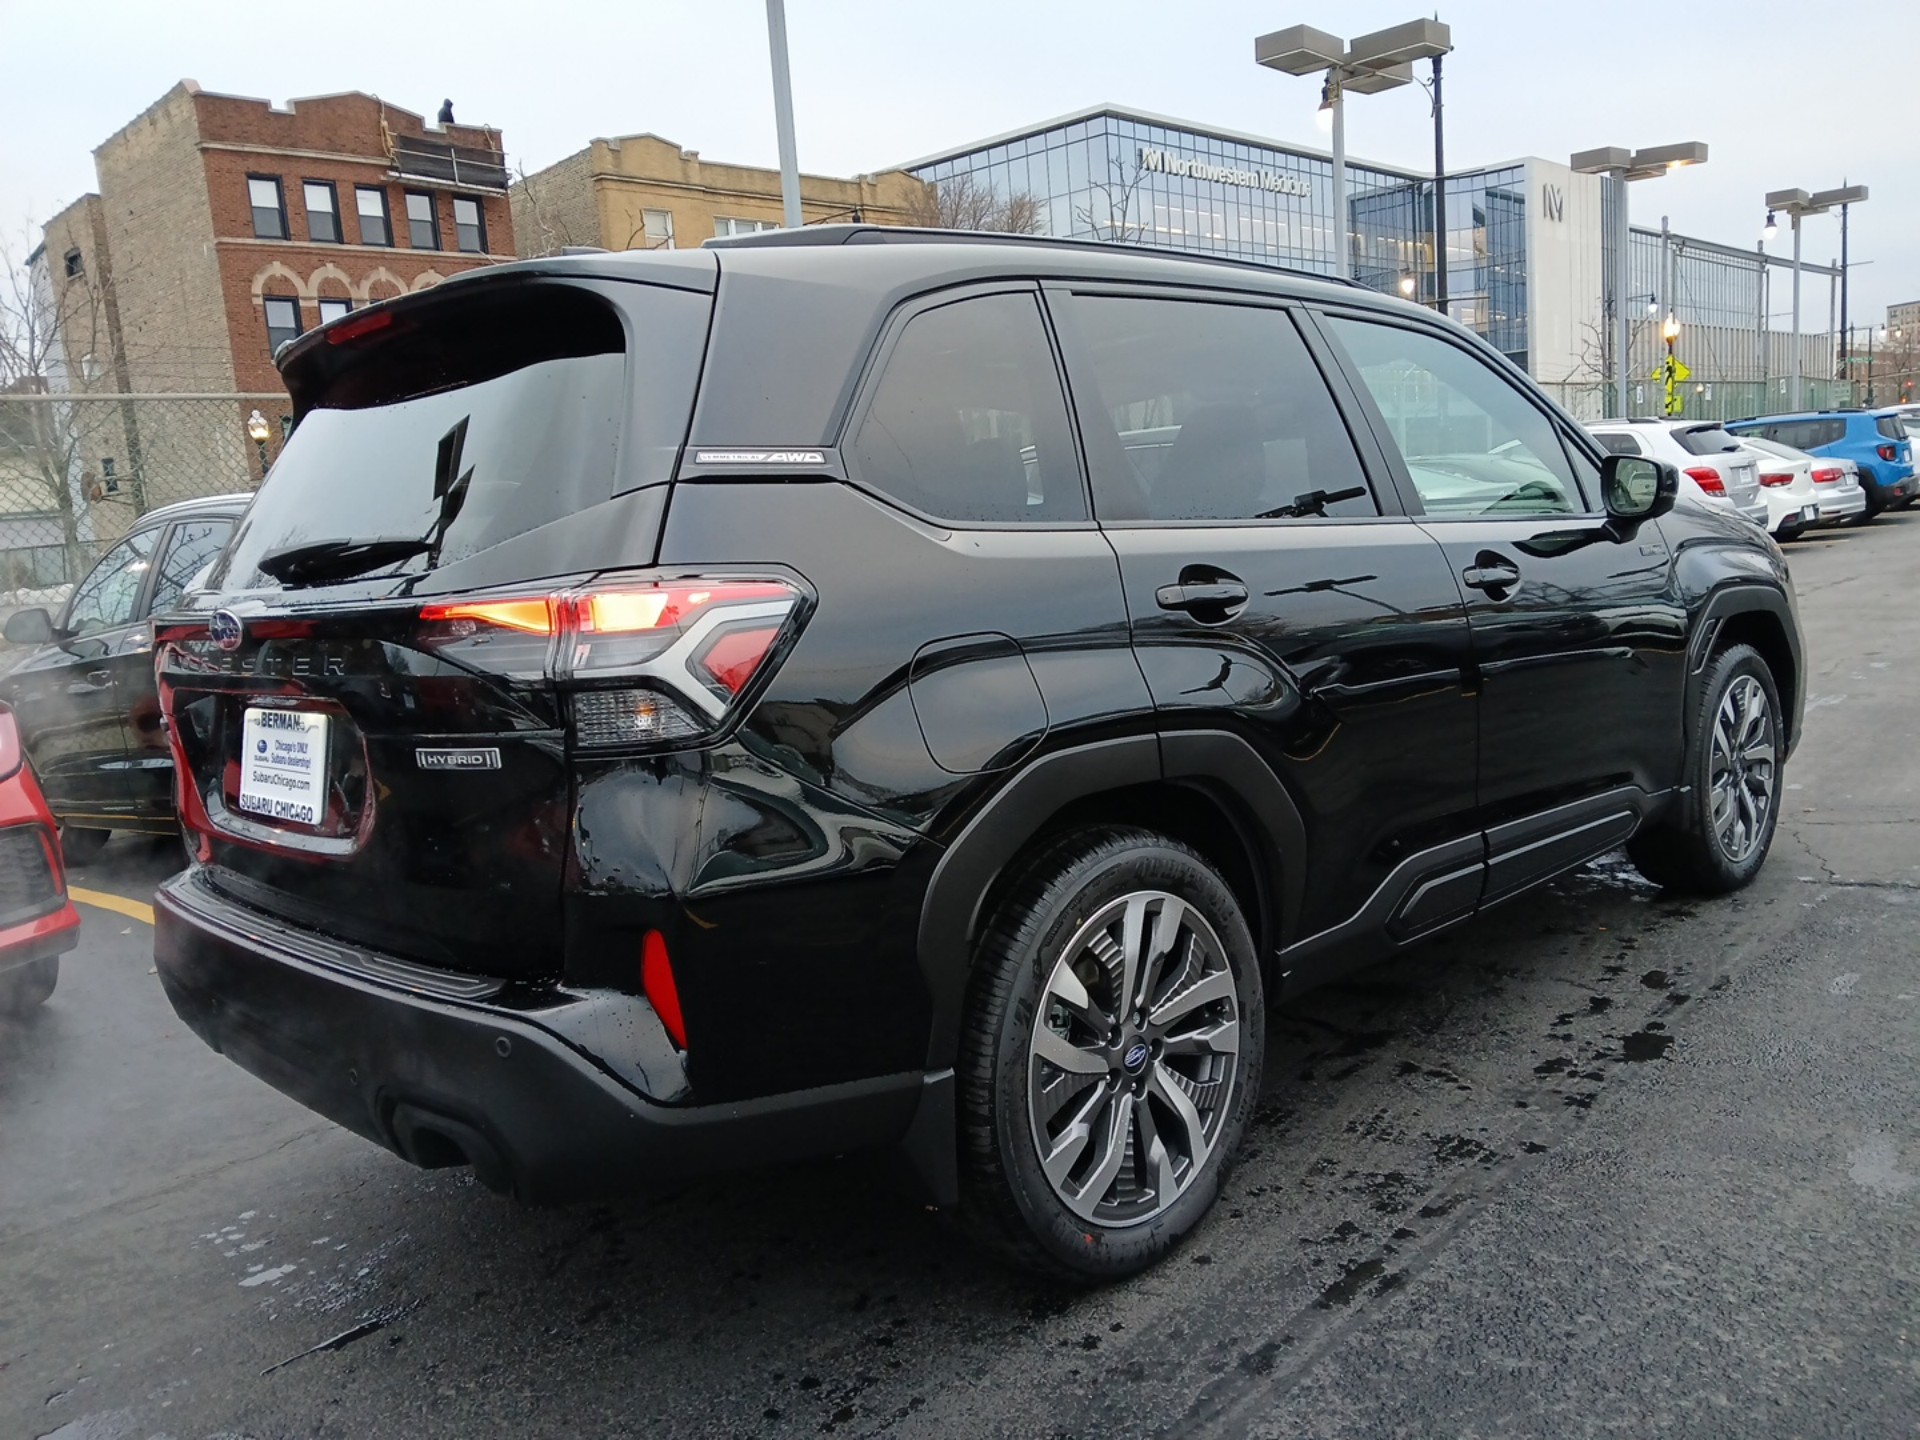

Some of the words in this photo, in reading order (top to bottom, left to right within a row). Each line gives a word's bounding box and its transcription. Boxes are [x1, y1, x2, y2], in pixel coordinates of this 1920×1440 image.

[1164, 151, 1260, 189] Northwestern
[1260, 169, 1313, 198] Medicine
[766, 451, 823, 463] AWD
[260, 711, 301, 731] BERMAN
[427, 755, 484, 765] HYBRID
[252, 771, 310, 791] SubaruChicago.com
[241, 793, 273, 814] SUBARU
[274, 800, 313, 822] CHICAGO
